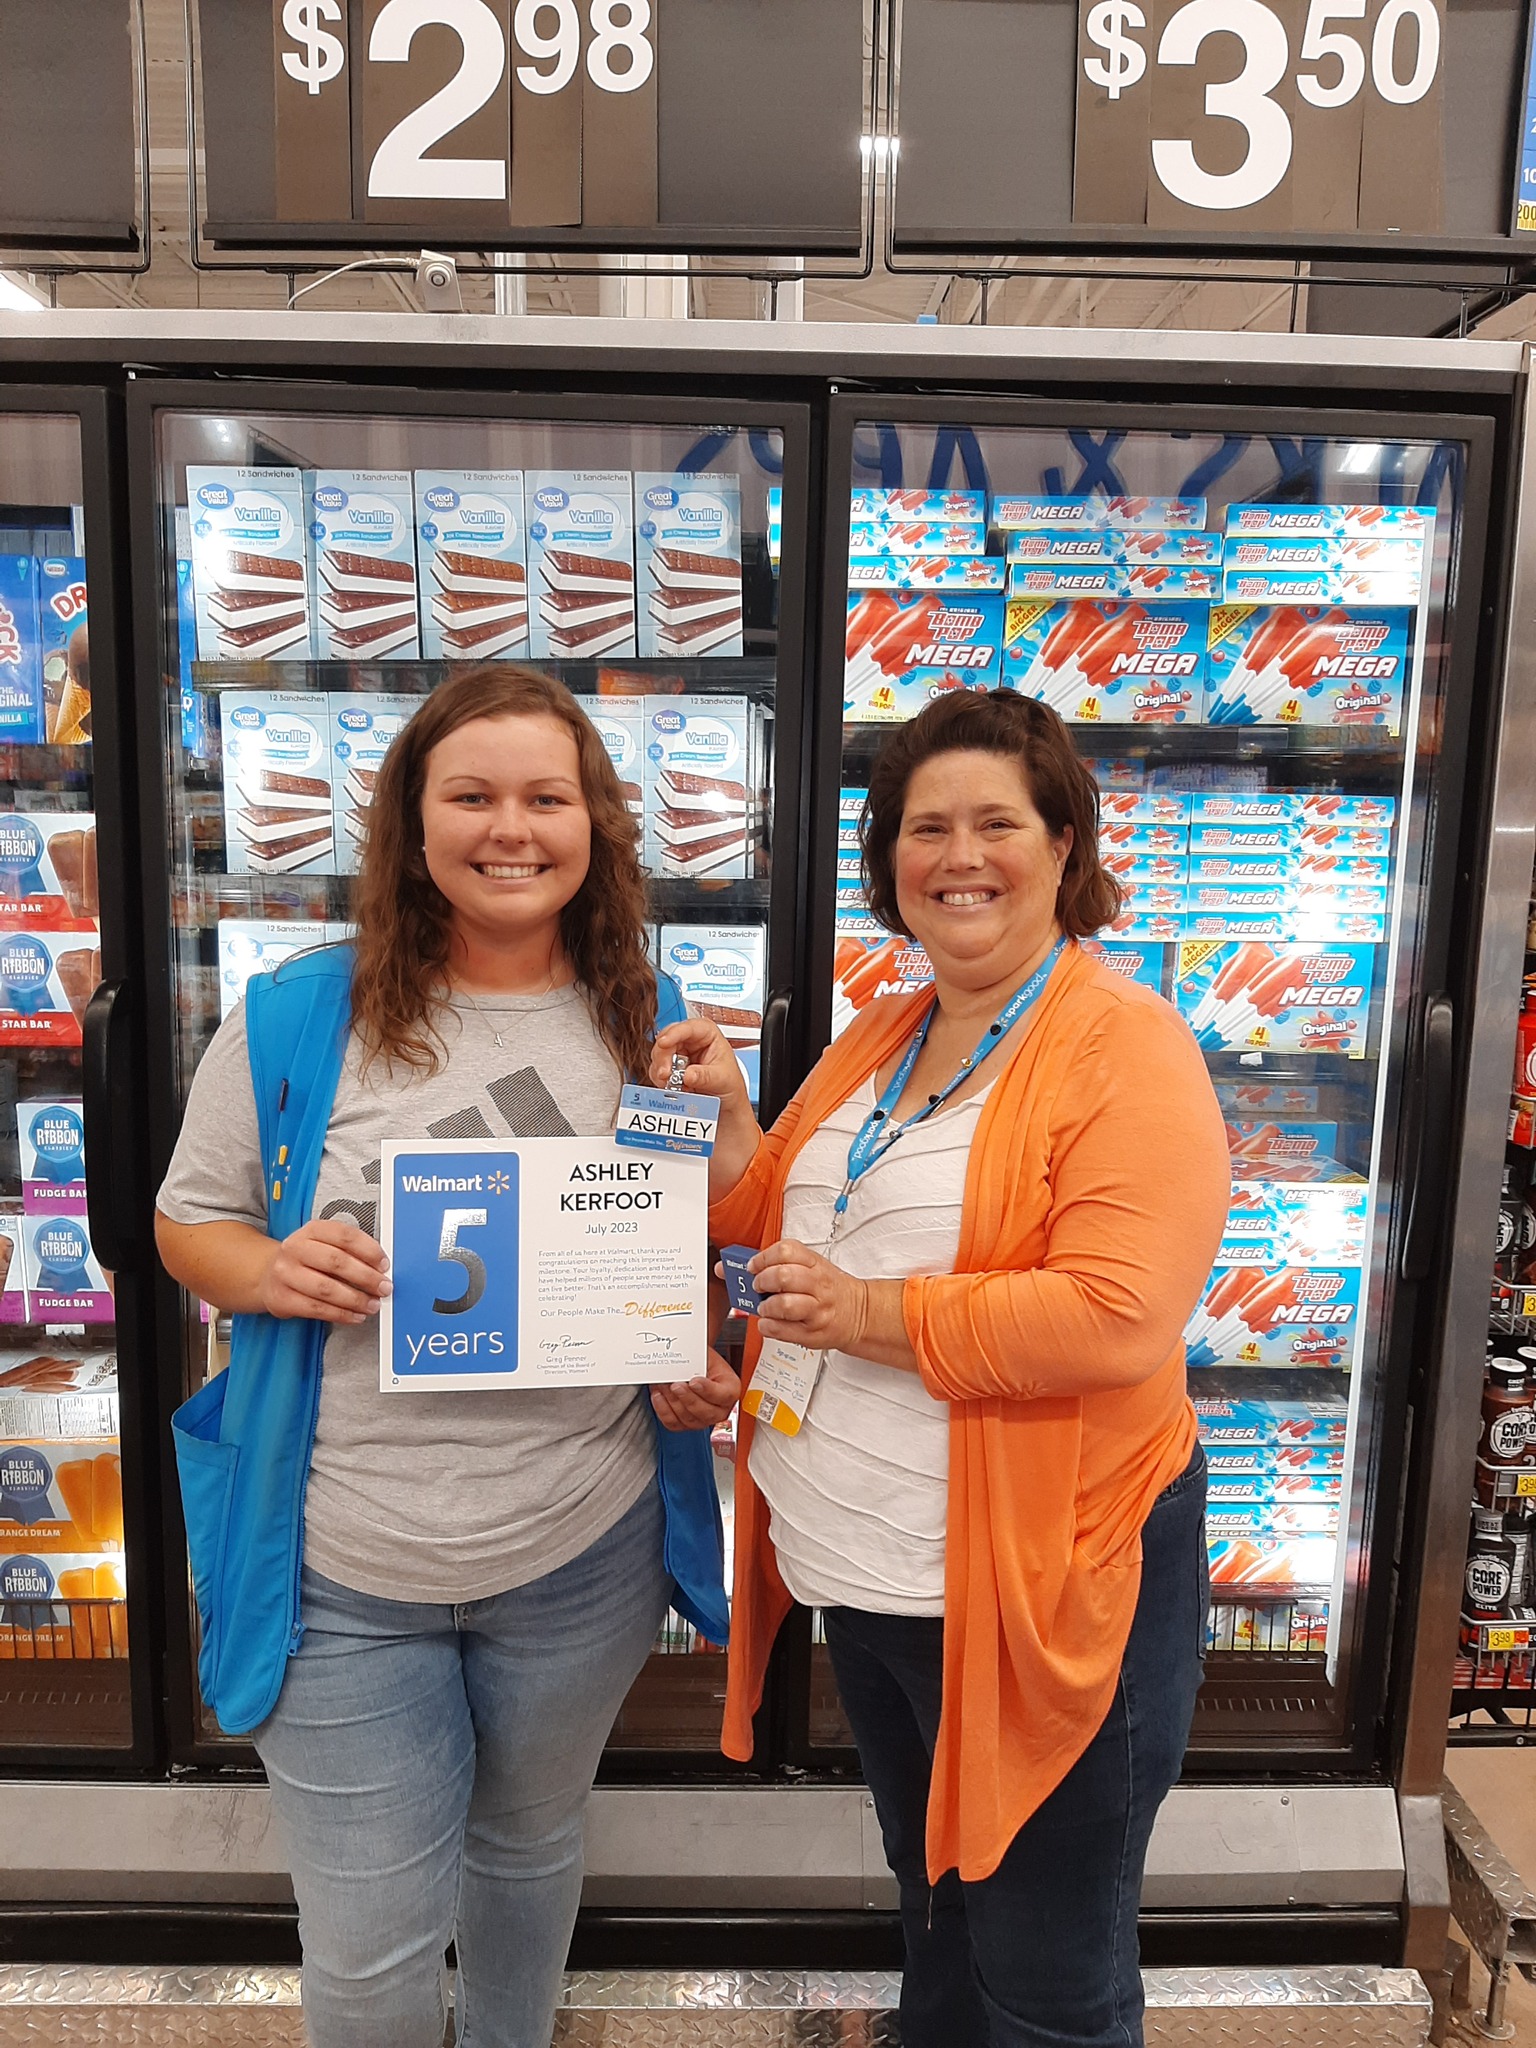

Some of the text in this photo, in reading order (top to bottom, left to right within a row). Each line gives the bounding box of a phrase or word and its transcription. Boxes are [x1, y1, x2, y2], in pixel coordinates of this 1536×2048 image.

[237, 470, 295, 478] 12 Sandwiches
[352, 473, 408, 482] 12 Sandwiches
[463, 473, 519, 482] 12 Sandwiches
[583, 474, 628, 482] Sandwiches
[692, 473, 737, 481] Sandwiches
[200, 488, 228, 500] Great
[315, 491, 342, 502] Great
[427, 491, 454, 502] Great
[537, 491, 563, 503] Great
[647, 491, 672, 502] Great
[235, 507, 281, 522] Vanilla
[348, 509, 394, 524] Vanilla
[460, 510, 505, 524] Vanilla
[569, 509, 614, 524] Vanilla
[678, 508, 723, 522] Vanilla
[1032, 506, 1085, 520] MEGA
[1269, 514, 1323, 528] MEGA
[1055, 576, 1108, 590] MEGA
[1185, 577, 1210, 588] Original
[1267, 582, 1321, 596] MEGA
[1009, 604, 1038, 632] BIGGER
[1212, 608, 1241, 635] BIGGER
[903, 643, 994, 669] MEGA
[1109, 652, 1200, 677] MEGA
[1311, 654, 1400, 679] MEGA
[691, 697, 744, 705] 12 Sandwiches
[879, 687, 890, 701] 4
[1133, 690, 1182, 708] Original
[1085, 697, 1096, 713] 4
[1334, 693, 1382, 711] Original
[234, 711, 260, 722] Great
[655, 715, 681, 725] Great
[266, 729, 310, 744] Vanilla
[686, 732, 729, 746] Vanilla
[1232, 803, 1282, 816] MEGA
[276, 925, 322, 933] Sandwiches
[9, 949, 35, 958] BLUE
[1182, 942, 1212, 968] BIGGER
[2, 957, 45, 974] RIBBON
[704, 964, 746, 977] Vanilla
[1004, 974, 1045, 1019] sparkgood
[1278, 986, 1366, 1007] MEGA
[2, 1019, 51, 1029] STAR BAR
[1301, 1021, 1348, 1037] Original
[649, 1100, 685, 1112] Walmart
[44, 1119, 70, 1129] BLUE
[628, 1113, 713, 1139] ASHLEY
[37, 1128, 79, 1147] RIBBON
[853, 1119, 881, 1159] parkgood
[569, 1162, 654, 1182] ASHLEY
[402, 1174, 482, 1193] Walmart
[34, 1188, 67, 1198] FUDGE
[560, 1191, 664, 1213] KERFOOT
[584, 1221, 639, 1236] July 2023
[48, 1232, 73, 1241] BLUE
[41, 1240, 83, 1258] RIBBON
[637, 1247, 655, 1255] thank
[656, 1248, 668, 1256] you
[1217, 1247, 1265, 1259] MEGA
[431, 1207, 488, 1316] 5
[538, 1258, 589, 1267] congratulations
[599, 1257, 627, 1265] reaching
[641, 1256, 675, 1264] impressive
[614, 1265, 647, 1273] dedication
[555, 1276, 577, 1284] helped
[612, 1275, 634, 1283] people
[683, 1273, 697, 1281] they
[738, 1276, 747, 1294] 5
[617, 1282, 668, 1290] accomplishment
[39, 1298, 94, 1308] FUDGE BAR
[540, 1309, 556, 1317] Our
[557, 1308, 583, 1317] People
[584, 1307, 605, 1316] Make
[624, 1301, 694, 1318] Difference
[737, 1297, 755, 1308] years
[1270, 1304, 1355, 1324] MEGA
[405, 1328, 505, 1367] years
[1292, 1337, 1338, 1351] Original
[633, 1352, 651, 1361] Doug
[1210, 1428, 1257, 1440] MEGA
[8, 1460, 35, 1470] BLUE
[1208, 1456, 1255, 1468] MEGA
[1, 1469, 45, 1486] RIBBON
[30, 1528, 61, 1537] DREAM
[12, 1568, 38, 1577] BLUE
[1472, 1567, 1503, 1585] CORE
[5, 1577, 48, 1593] RIBBON
[1472, 1582, 1502, 1596] POWER
